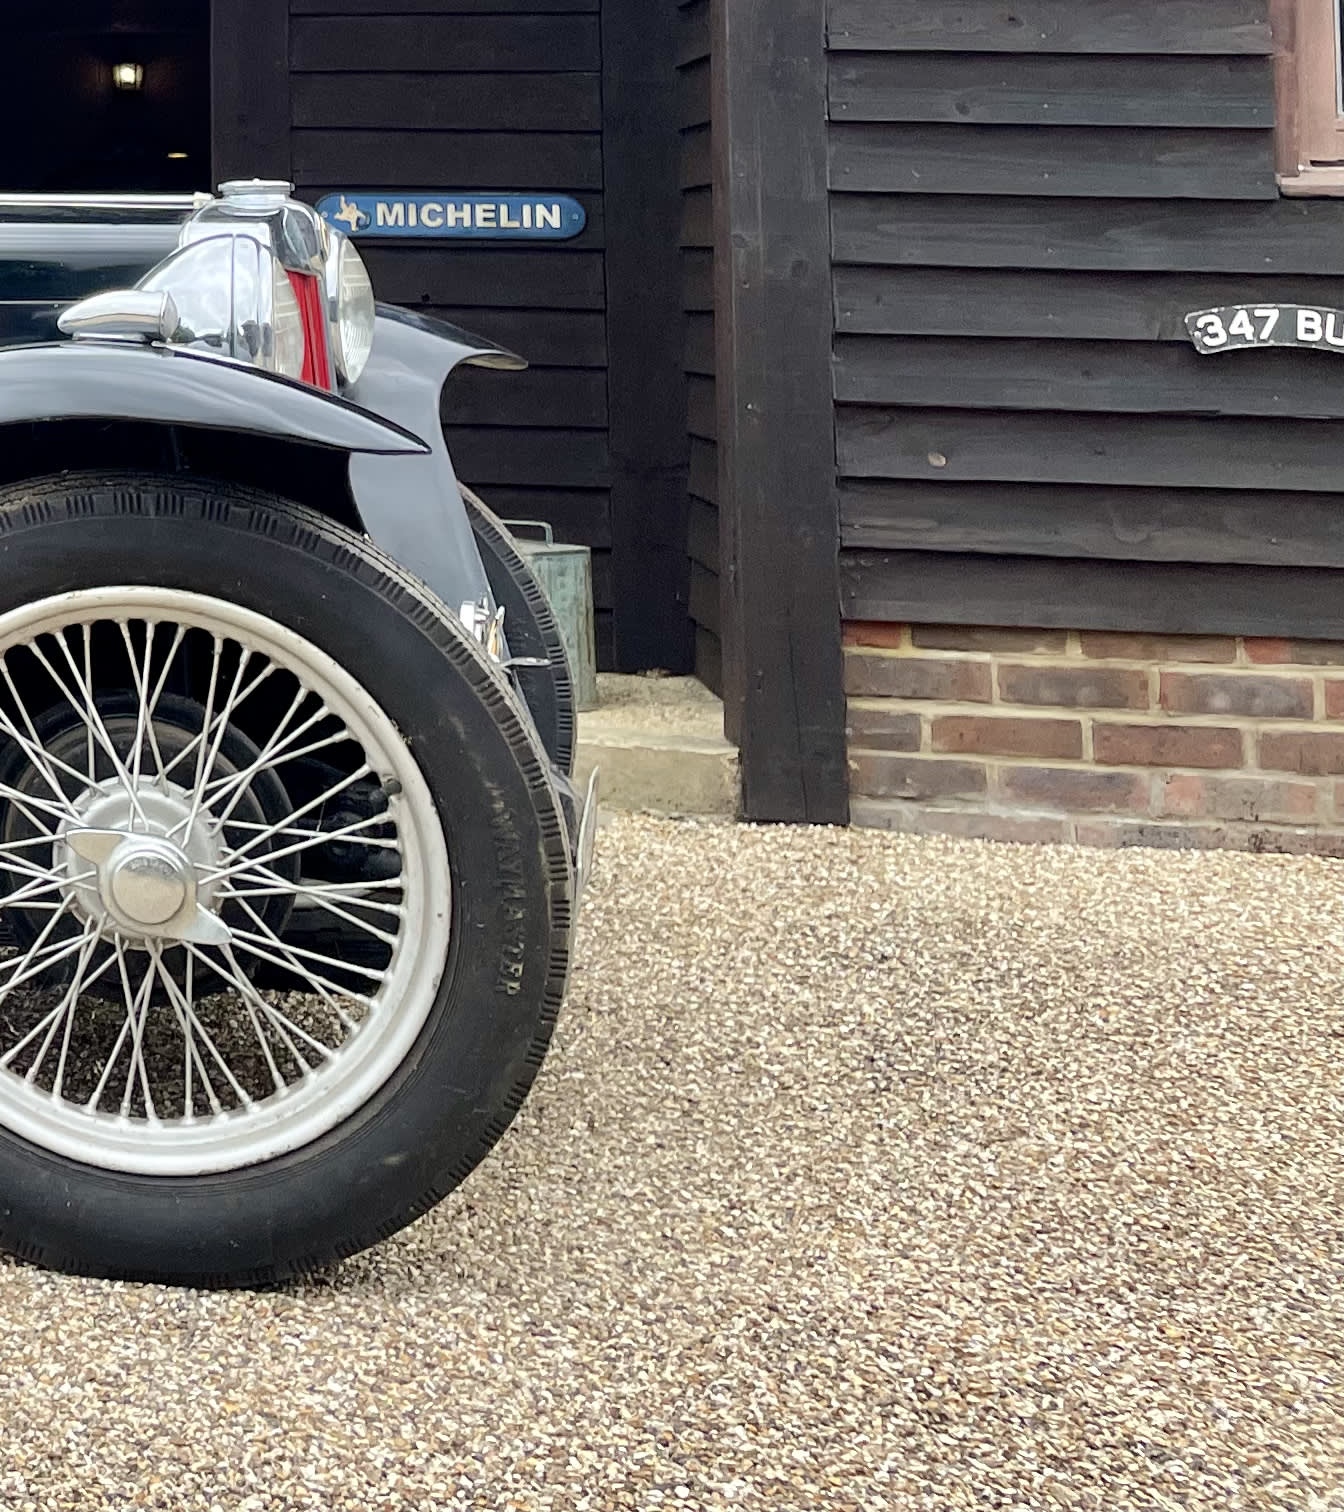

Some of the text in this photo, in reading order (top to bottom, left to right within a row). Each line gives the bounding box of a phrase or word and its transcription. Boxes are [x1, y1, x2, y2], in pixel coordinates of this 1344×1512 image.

[375, 201, 562, 230] MICHELIN
[1196, 308, 1344, 348] 347 BU
